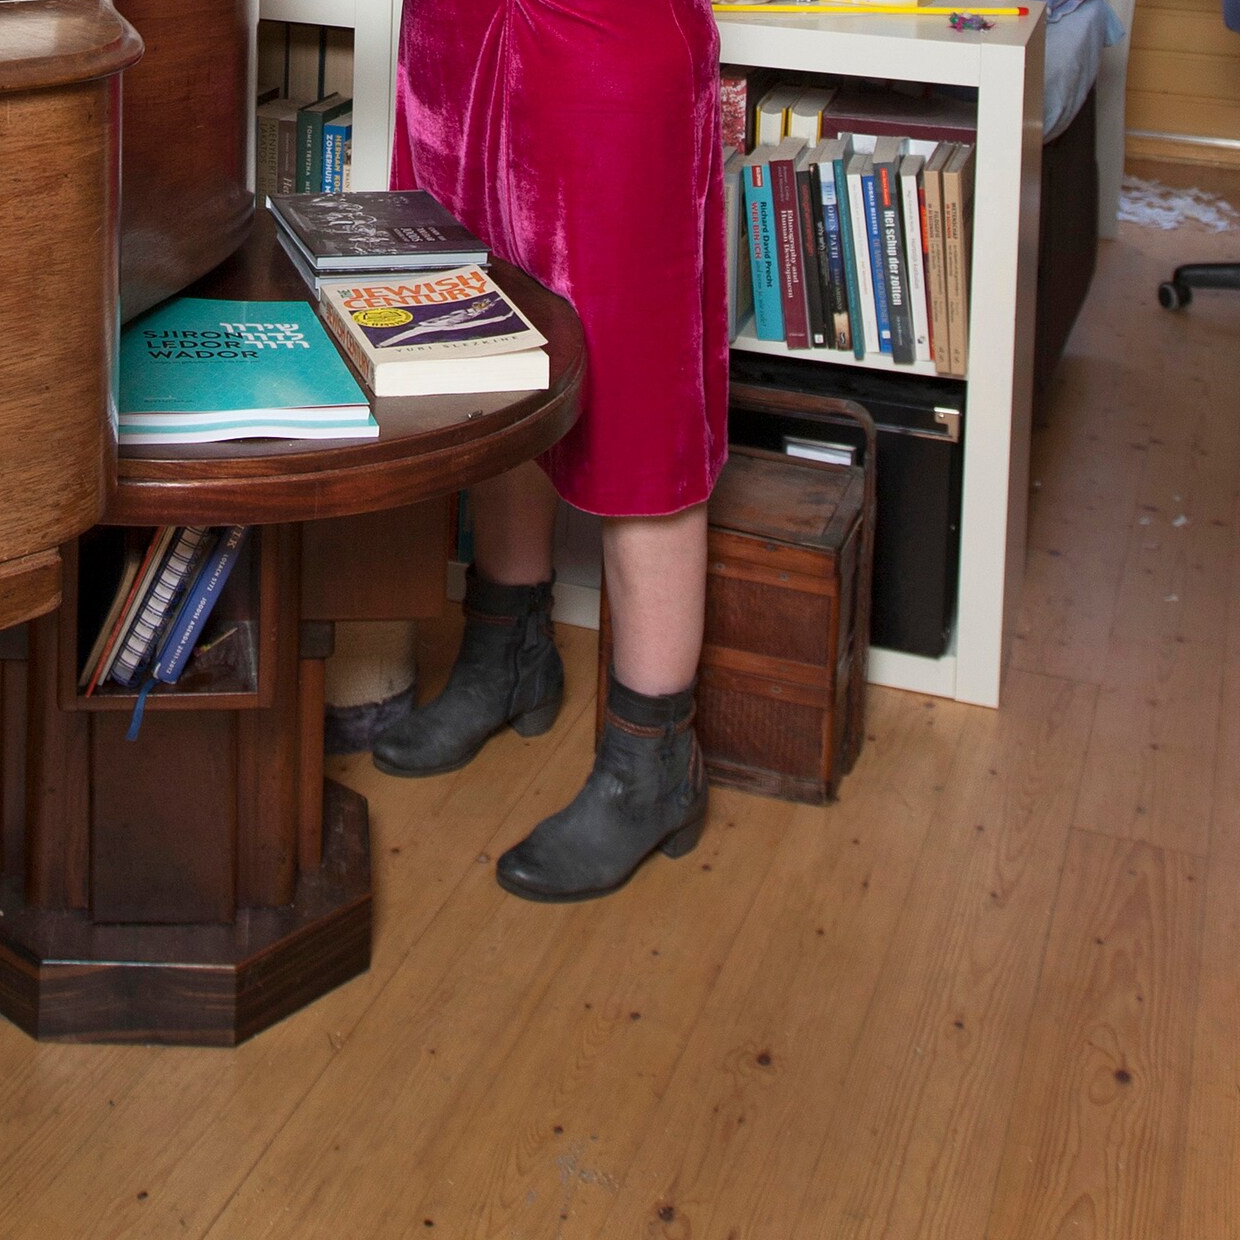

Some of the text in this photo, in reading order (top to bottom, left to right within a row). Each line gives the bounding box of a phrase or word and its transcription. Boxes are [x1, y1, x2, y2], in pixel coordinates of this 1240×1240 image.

[325, 134, 333, 183] ZOMERHUIS
[333, 135, 342, 193] HERMAN KOC
[751, 201, 759, 222] WER
[827, 205, 836, 231] OPEN
[867, 181, 878, 235] RONALD MEESTER
[884, 210, 895, 227] Het
[760, 201, 774, 288] Richard David Precht
[787, 209, 798, 264] Ethnography
[830, 233, 838, 259] PATH
[886, 229, 898, 256] schip
[780, 210, 793, 298] Human Development
[889, 257, 899, 274] der
[343, 280, 488, 309] CENTURY
[350, 271, 487, 299] JEWISH
[890, 275, 902, 306] zotten
[142, 330, 244, 339] SJIRON
[146, 340, 242, 349] LEDOR
[396, 335, 519, 353] YURI SLEZKINE
[148, 350, 259, 359] WADOR
[194, 597, 208, 620] JOODSE
[180, 621, 196, 646] AGENDA
